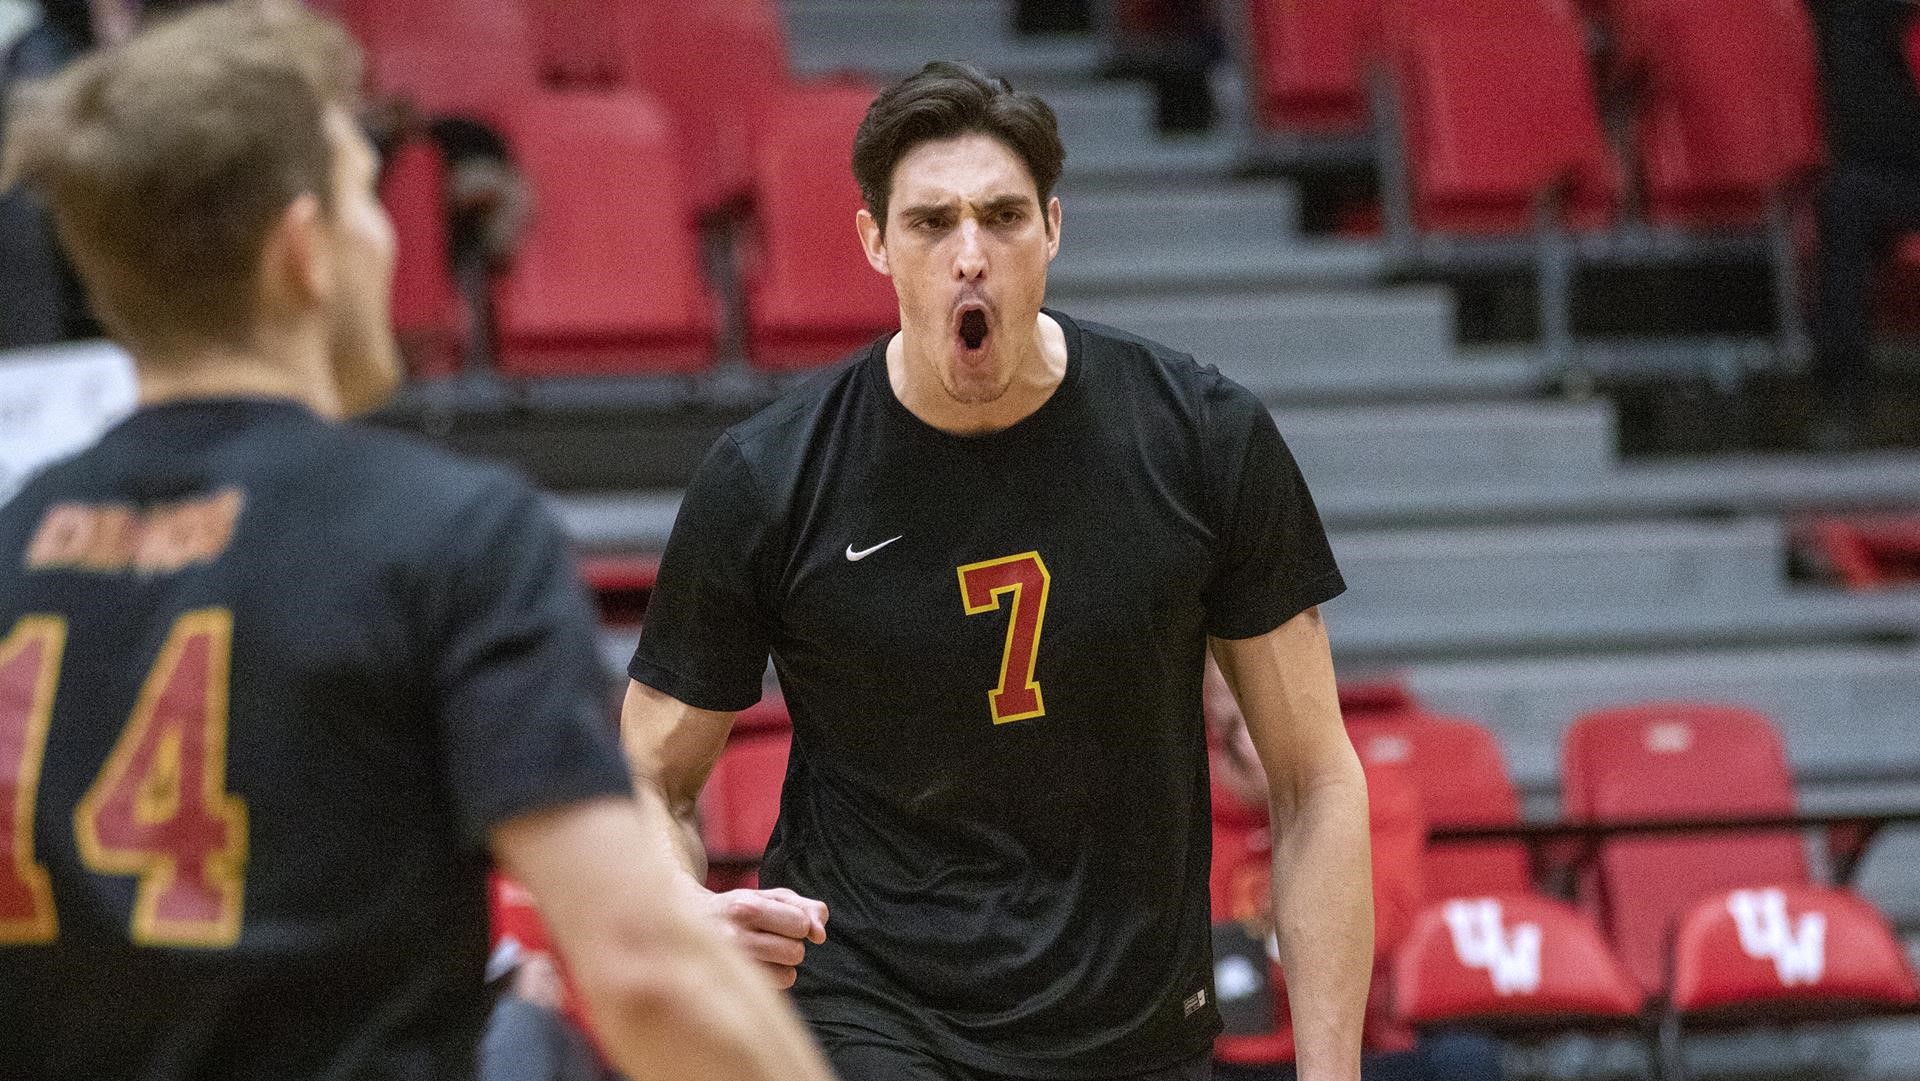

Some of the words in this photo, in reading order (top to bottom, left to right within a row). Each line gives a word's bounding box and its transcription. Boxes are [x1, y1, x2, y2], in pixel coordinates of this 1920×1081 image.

[957, 551, 1051, 725] 7
[0, 609, 249, 947] 14
[1445, 898, 1542, 994] UW
[1728, 888, 1825, 985] UW
